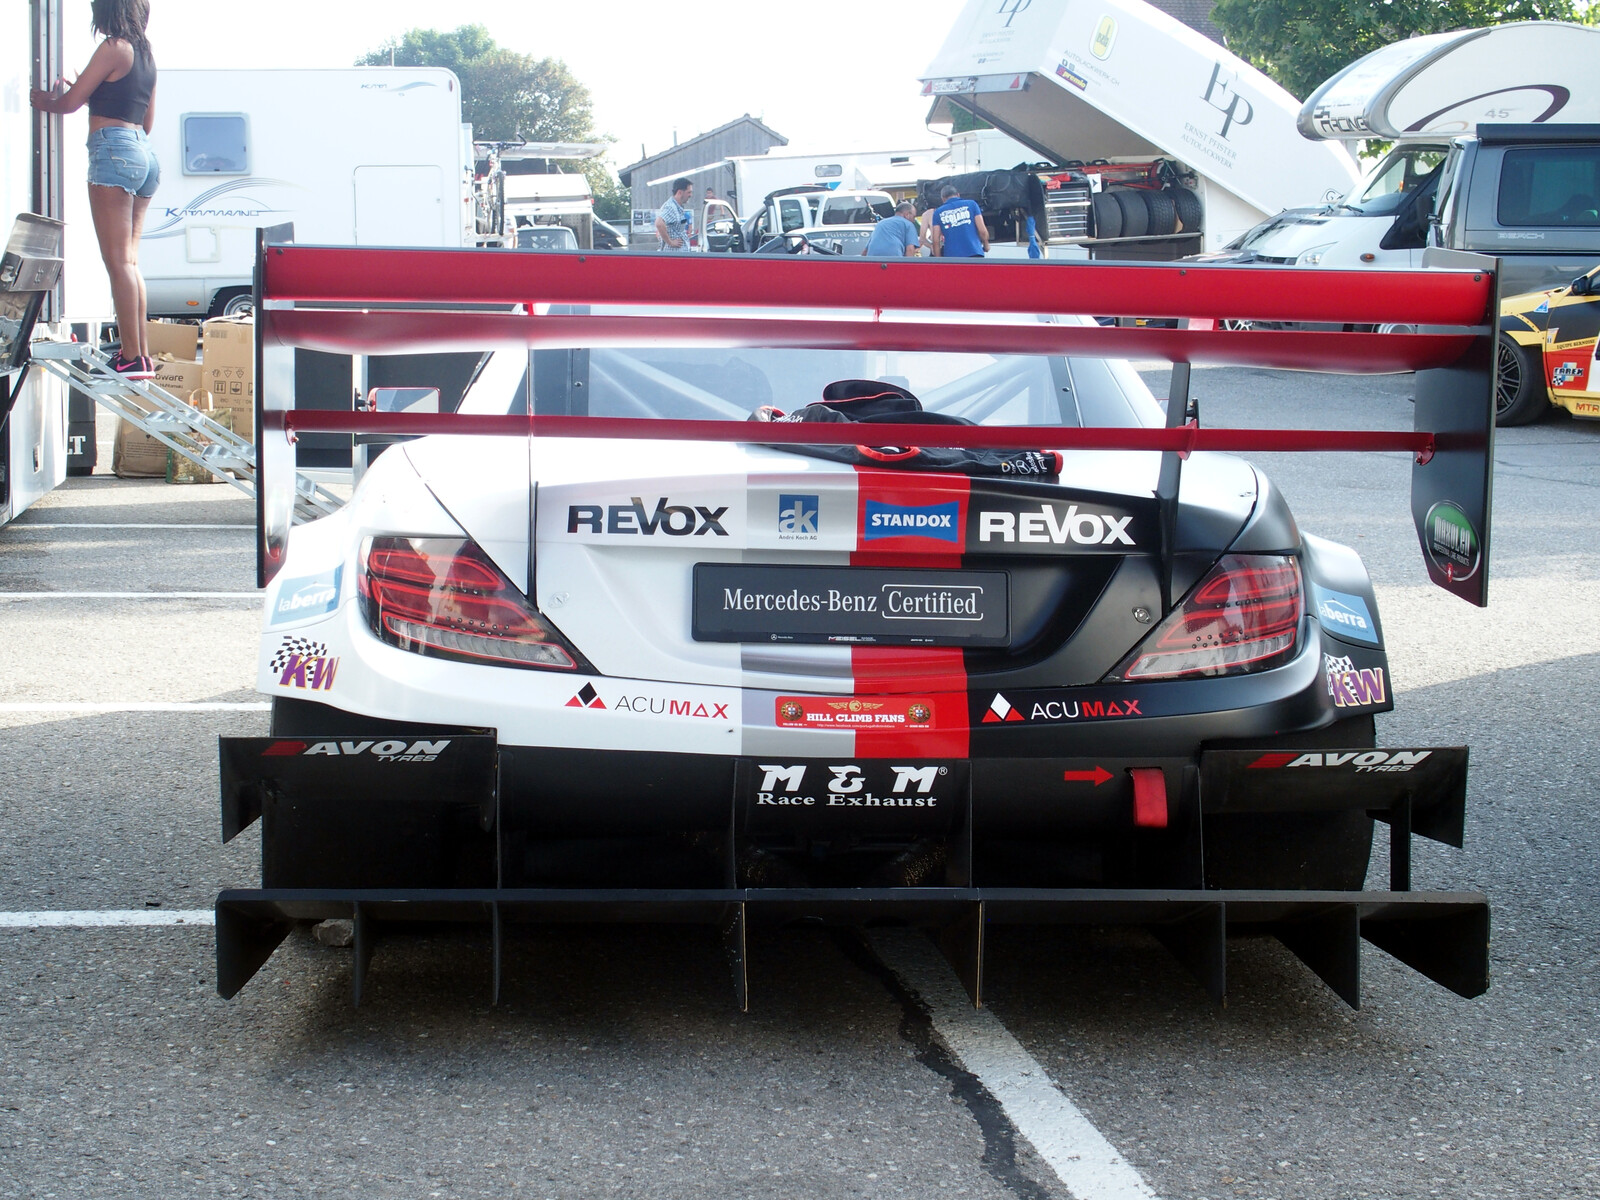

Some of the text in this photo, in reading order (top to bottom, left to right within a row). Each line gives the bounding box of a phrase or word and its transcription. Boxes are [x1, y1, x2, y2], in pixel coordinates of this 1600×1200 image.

[1484, 107, 1511, 119] 45
[1181, 132, 1233, 169] AUTOLACKWERK
[1184, 121, 1238, 161] ERNST PFISTER
[567, 496, 729, 536] REVOX
[778, 500, 819, 533] ak
[871, 513, 951, 528] STANDOX
[979, 504, 1137, 546] REVOX
[278, 587, 337, 612] laberra
[723, 588, 977, 615] Mercedes-Benz Certified
[279, 652, 341, 692] KW
[1328, 667, 1386, 707] KW
[614, 695, 729, 720] ACUMAX
[806, 713, 906, 723] HILL CLIMB FANS
[1030, 699, 1143, 720] ACUMAX
[303, 739, 451, 756] AVON
[377, 754, 438, 762] TYRES
[1286, 751, 1433, 768] AVON
[758, 764, 807, 792] M
[827, 765, 867, 793] &
[1354, 764, 1416, 773] TYRES
[756, 792, 937, 808] Race Exhaust
